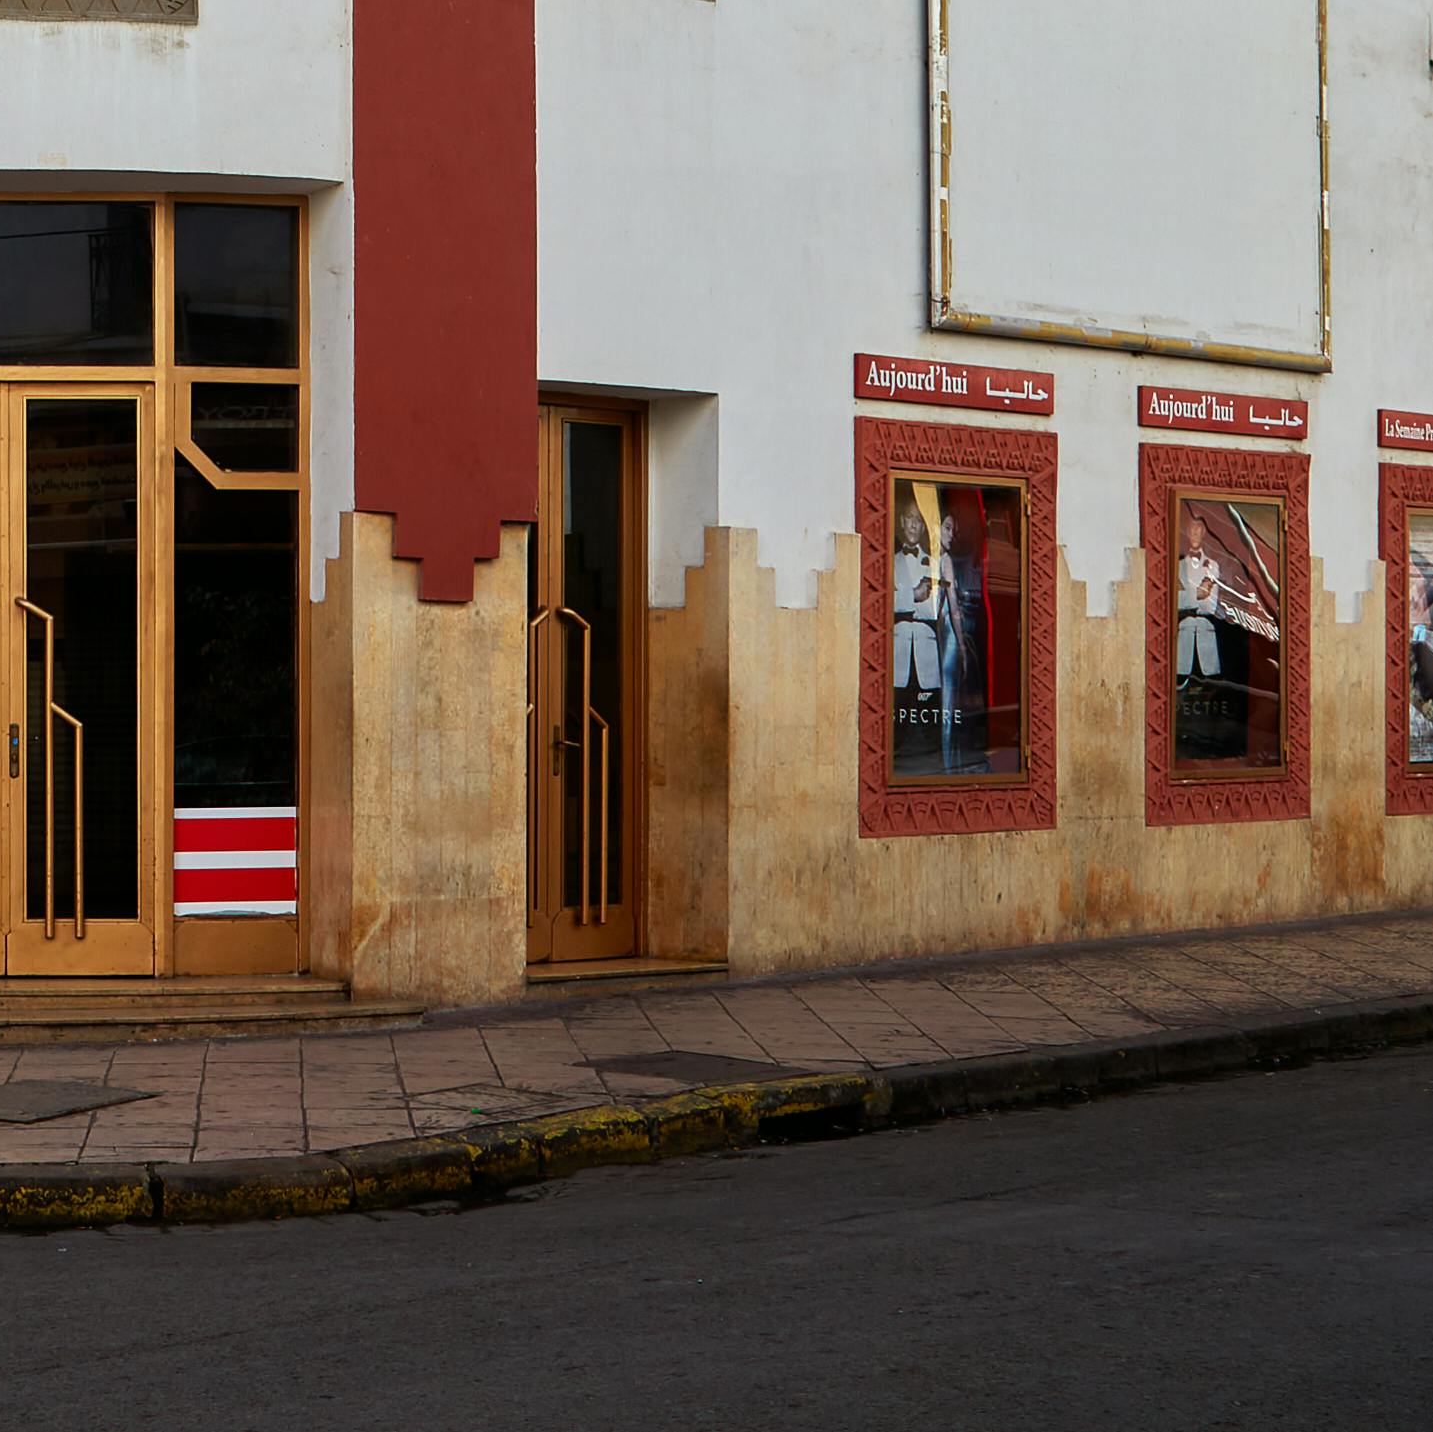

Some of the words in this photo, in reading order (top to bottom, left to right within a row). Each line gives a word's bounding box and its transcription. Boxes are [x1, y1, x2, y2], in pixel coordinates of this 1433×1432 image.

[865, 360, 968, 396] Aujourd'hui
[986, 376, 1049, 404] حاليا
[1148, 391, 1235, 424] Aujourd'hui
[1249, 405, 1304, 430] حاليا
[1385, 418, 1394, 437] La
[893, 709, 962, 724] PECTRE
